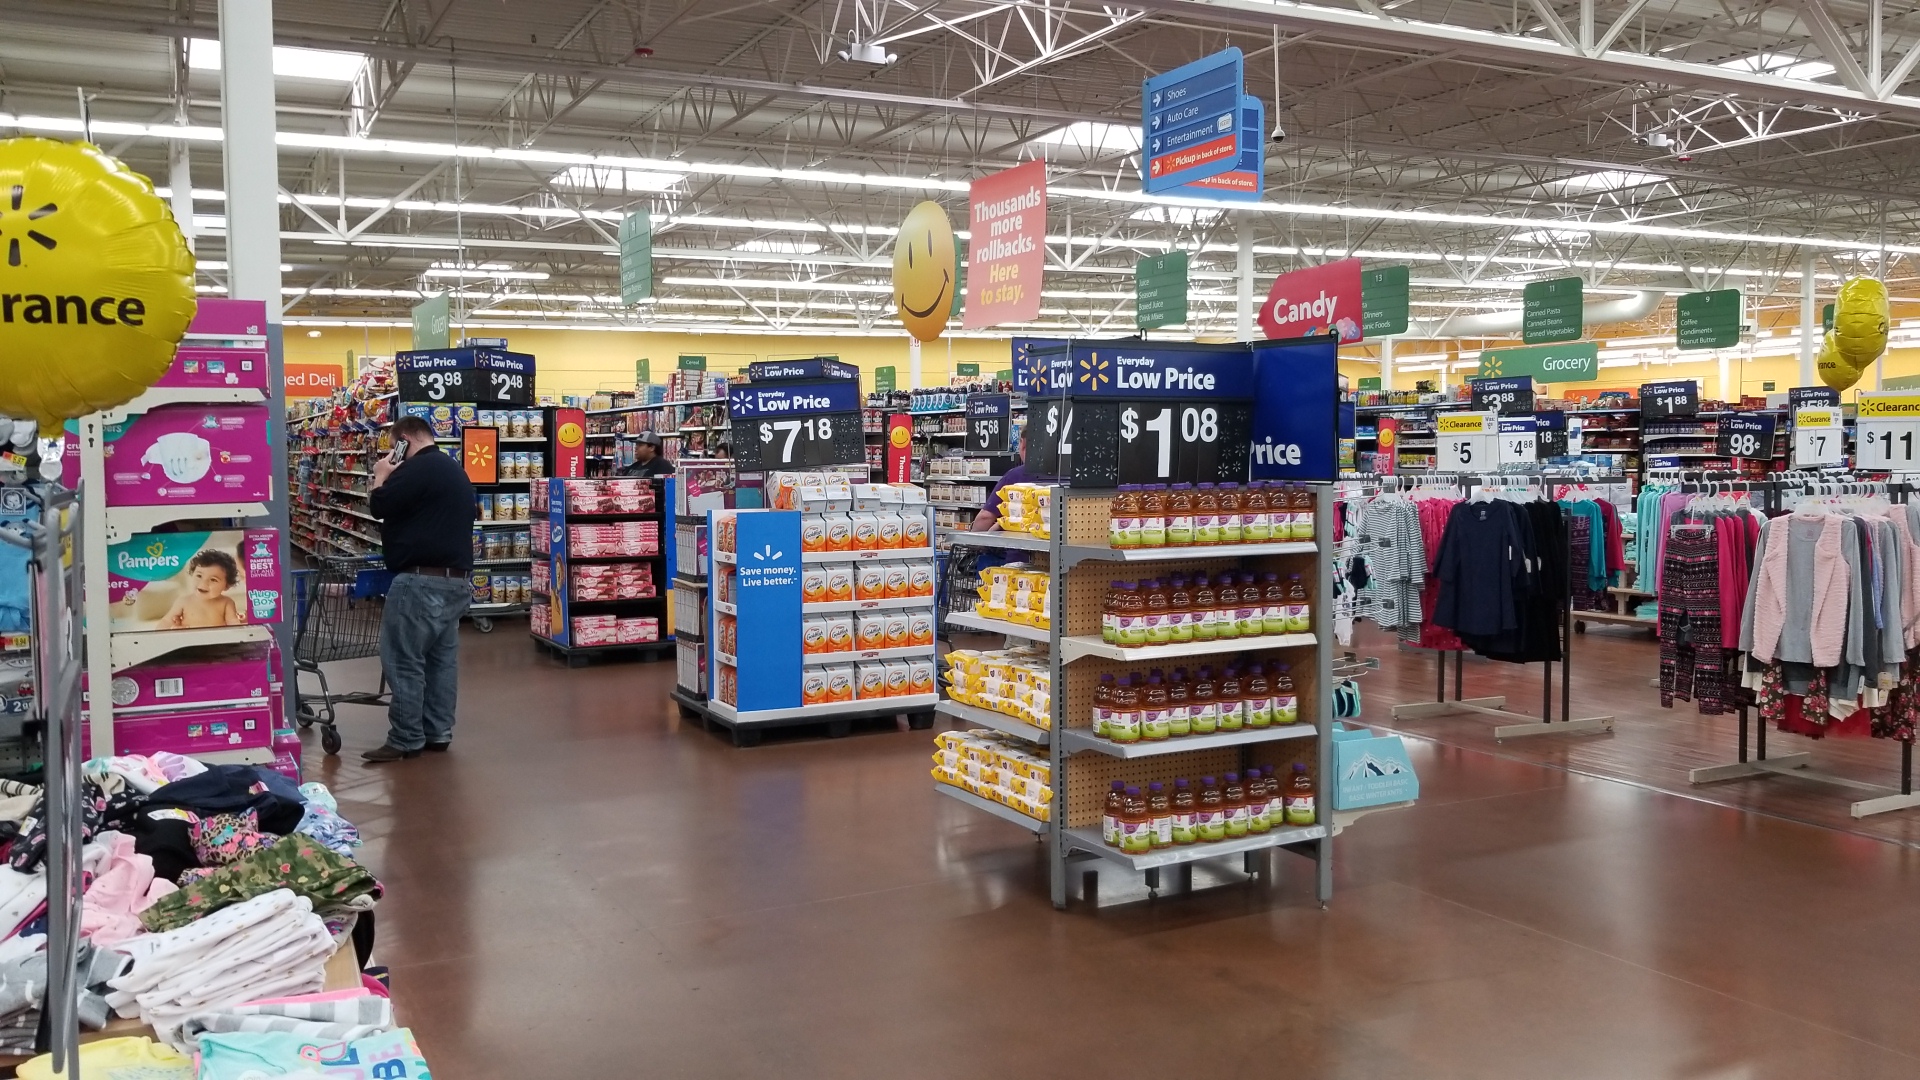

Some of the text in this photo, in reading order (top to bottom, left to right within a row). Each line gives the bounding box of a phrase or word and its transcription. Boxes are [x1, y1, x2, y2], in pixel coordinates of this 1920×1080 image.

[1167, 87, 1186, 101] Shoes
[1167, 106, 1199, 124] Auto Care
[1167, 125, 1213, 146] Entertainment
[1175, 152, 1196, 167] Pickup
[1202, 150, 1213, 160] back
[1214, 148, 1219, 156] of
[1219, 144, 1233, 154] store.
[1210, 176, 1216, 184] in
[974, 186, 1041, 223] Thousands
[990, 215, 1022, 236] more
[976, 233, 1036, 264] rollbacks.
[1157, 261, 1164, 269] 15
[990, 264, 1018, 284] Here
[1375, 274, 1382, 282] 13
[981, 284, 1024, 305] to stay.
[1139, 290, 1158, 300] Seasonal
[1139, 301, 1164, 310] Boxed Juice
[1273, 290, 1338, 325] Candy
[1526, 300, 1540, 308] Soup
[1139, 314, 1150, 322] Drink
[1364, 311, 1383, 319] Dinners
[432, 315, 447, 336] Grocery
[1374, 321, 1390, 329] Foods
[1526, 318, 1562, 328] Canned Beans
[1526, 327, 1575, 338] Canned Vegetables
[1681, 327, 1712, 336] Condiments
[414, 358, 456, 368] Low Price
[490, 358, 524, 370] Low Price
[1116, 356, 1154, 368] Everyday
[1543, 356, 1590, 372] Grocery
[765, 368, 804, 377] Low Price
[831, 368, 841, 377] Low
[309, 373, 336, 386] Deli
[1116, 367, 1215, 390] Low Price
[1500, 382, 1518, 390] Price
[758, 395, 830, 412] Low Price
[974, 404, 998, 414] Low Price
[1450, 420, 1482, 428] Clearance
[1730, 434, 1760, 455] 98¢
[1810, 436, 1826, 456] $7
[1250, 436, 1302, 466] rice
[1453, 442, 1472, 464] $5
[118, 551, 179, 570] Pampers
[740, 566, 797, 575] Save money.
[742, 577, 793, 587] Live better.
[249, 590, 278, 598] Huge
[1366, 790, 1386, 799] WINTER
